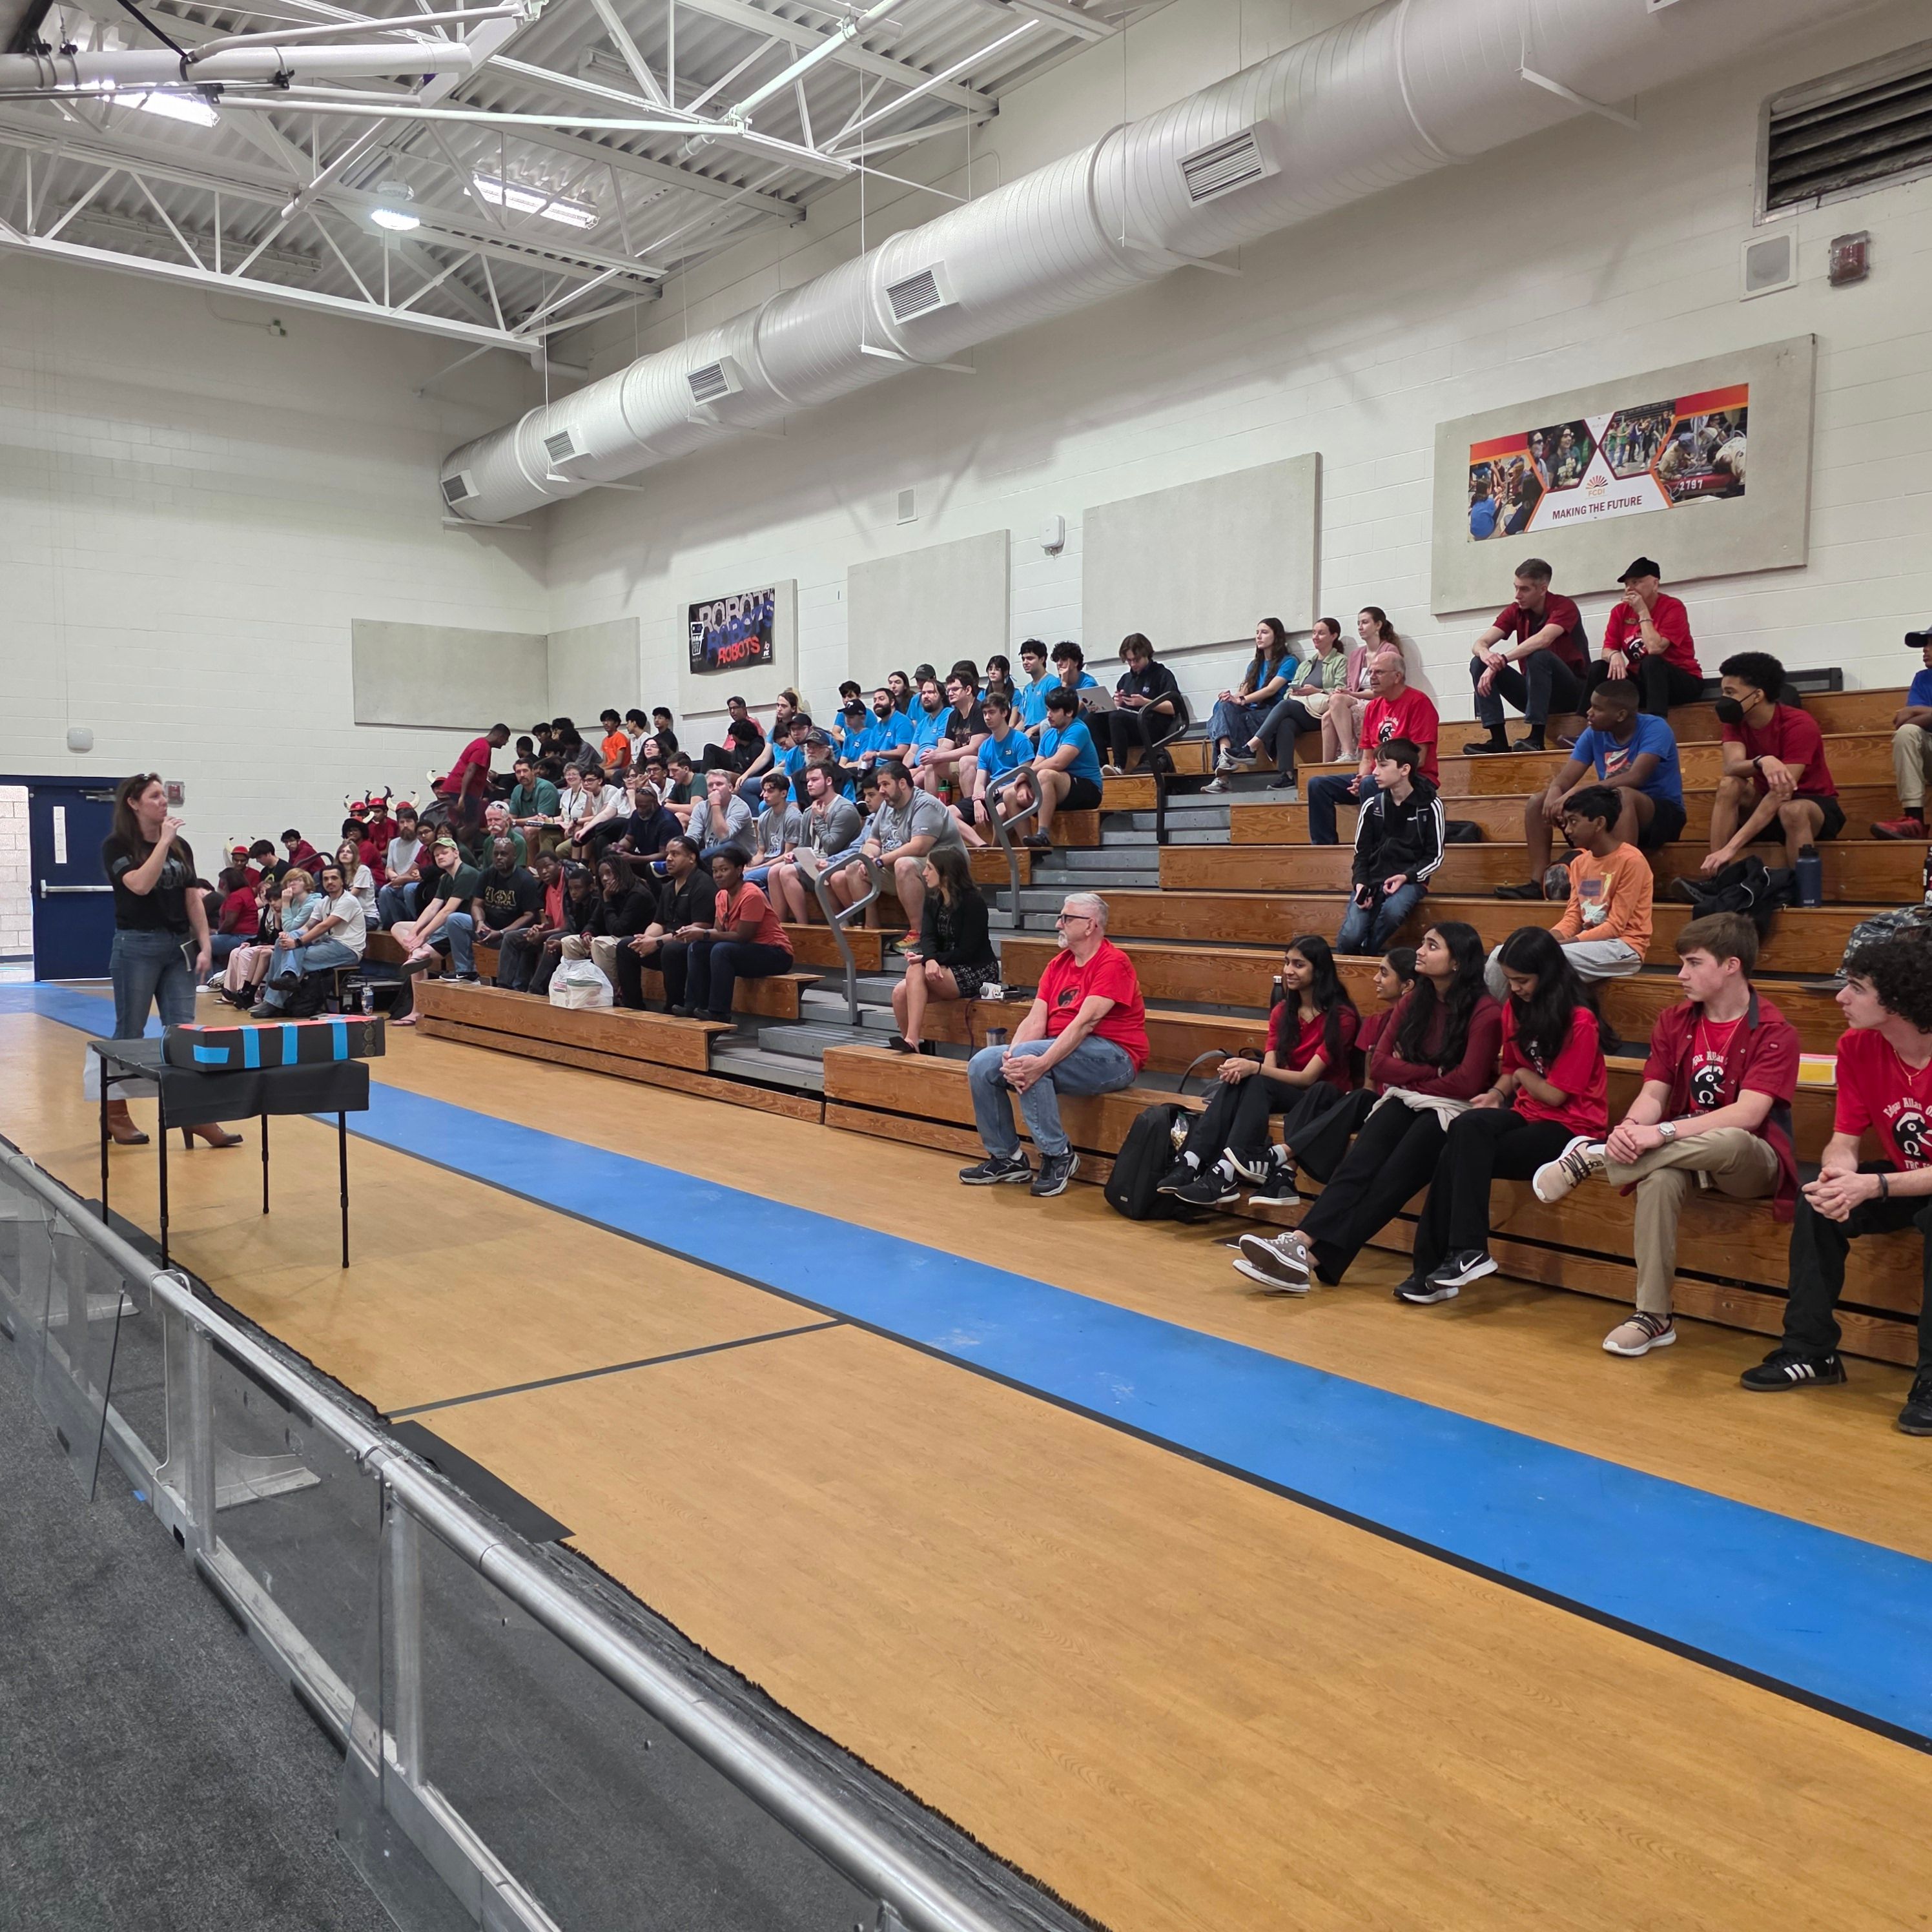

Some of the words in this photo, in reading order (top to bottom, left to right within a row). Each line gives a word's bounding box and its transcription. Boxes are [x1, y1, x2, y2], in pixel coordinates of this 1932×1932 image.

[1552, 505, 1587, 520] MAKING
[1588, 502, 1606, 513] THE
[1607, 495, 1643, 511] FUTURE
[716, 635, 760, 666] ROBOTS
[1902, 1097, 1922, 1111] Allan
